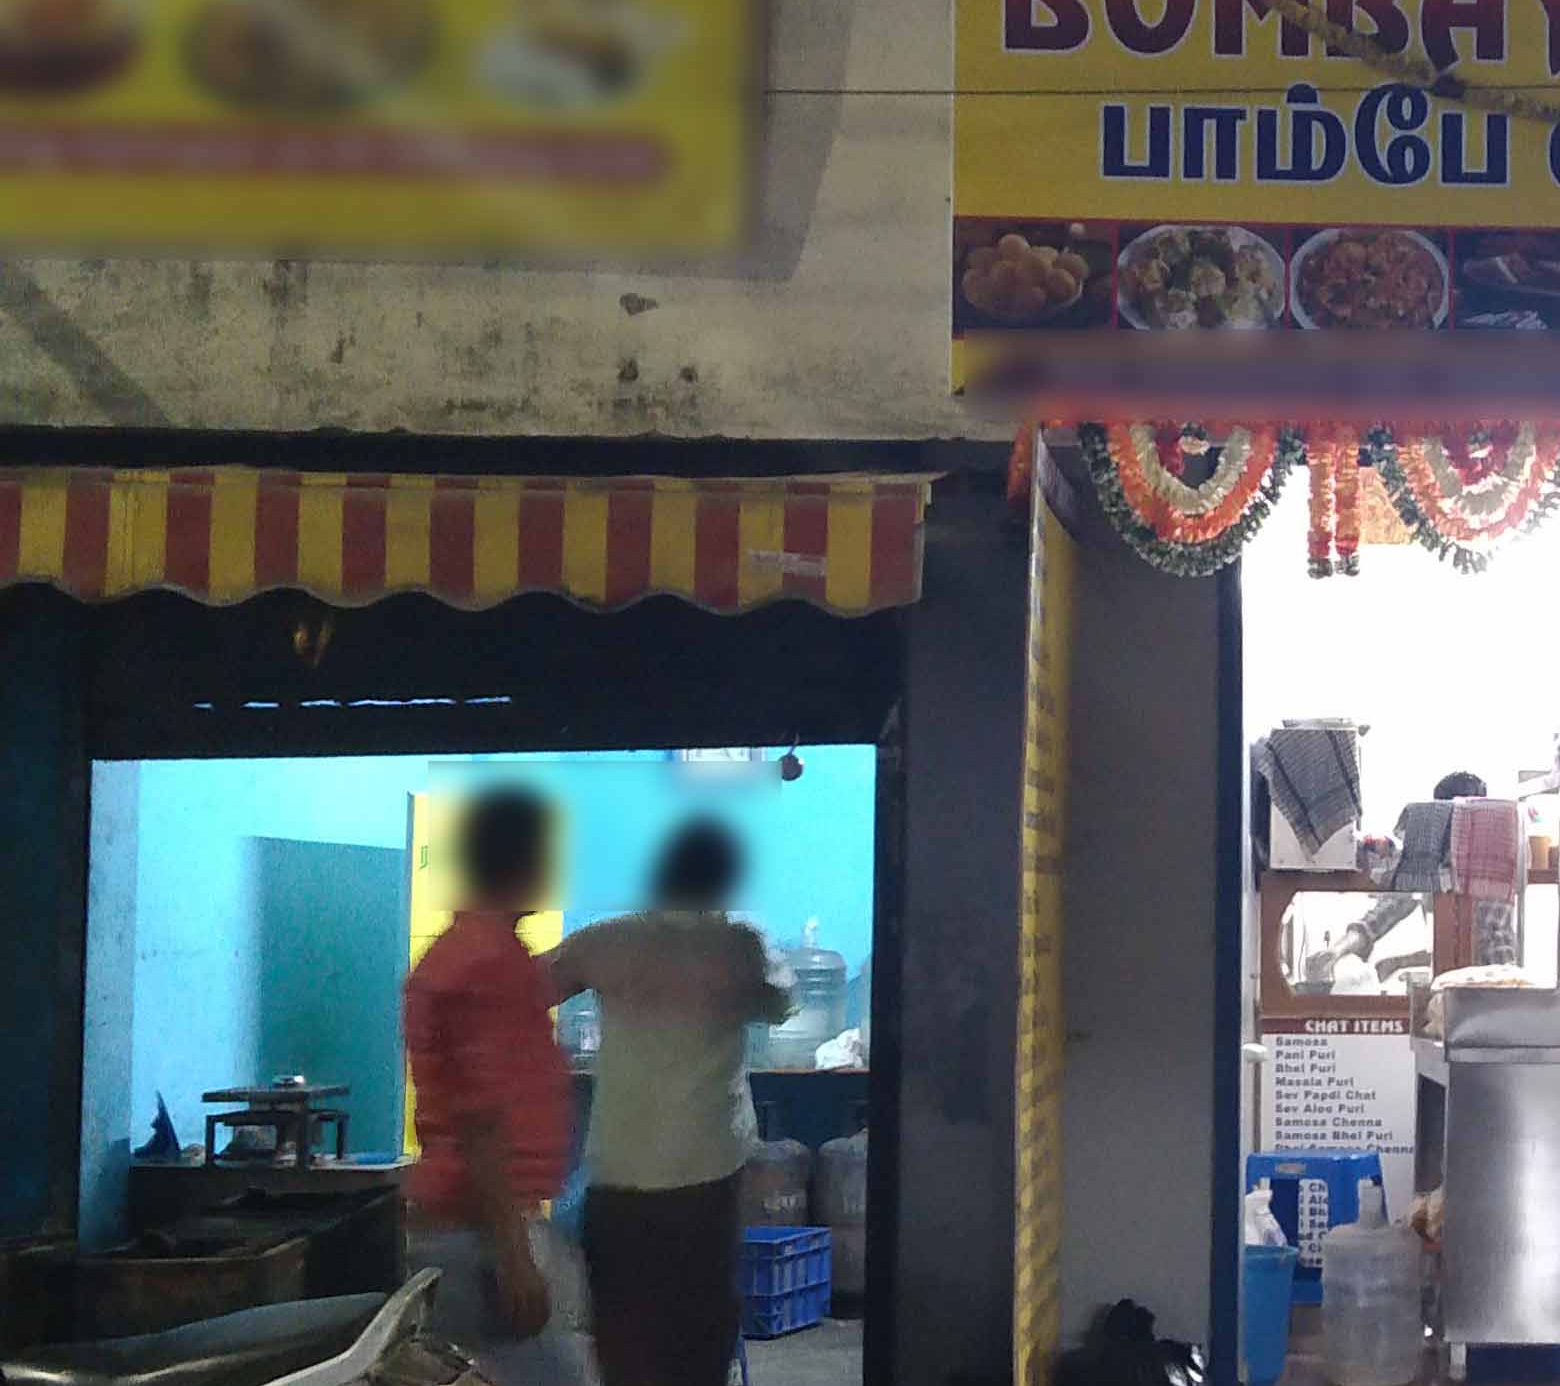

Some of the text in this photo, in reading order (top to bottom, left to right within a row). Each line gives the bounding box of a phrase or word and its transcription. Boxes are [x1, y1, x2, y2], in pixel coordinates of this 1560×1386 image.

[1098, 82, 1511, 189] பாம்பே
[1304, 1020, 1404, 1033] CHAT ITEMS
[1275, 1037, 1328, 1046] Samosa
[1275, 1050, 1336, 1059] Pani Puri
[1275, 1063, 1336, 1073] Bhel Puri
[1275, 1077, 1354, 1086] Masala Puri
[1275, 1090, 1376, 1102] Sev Papdi Chat
[1275, 1103, 1365, 1113] Sev Aloo Puri
[1275, 1117, 1327, 1127] Samosa
[1275, 1130, 1393, 1140] Samosa Bhel Puri
